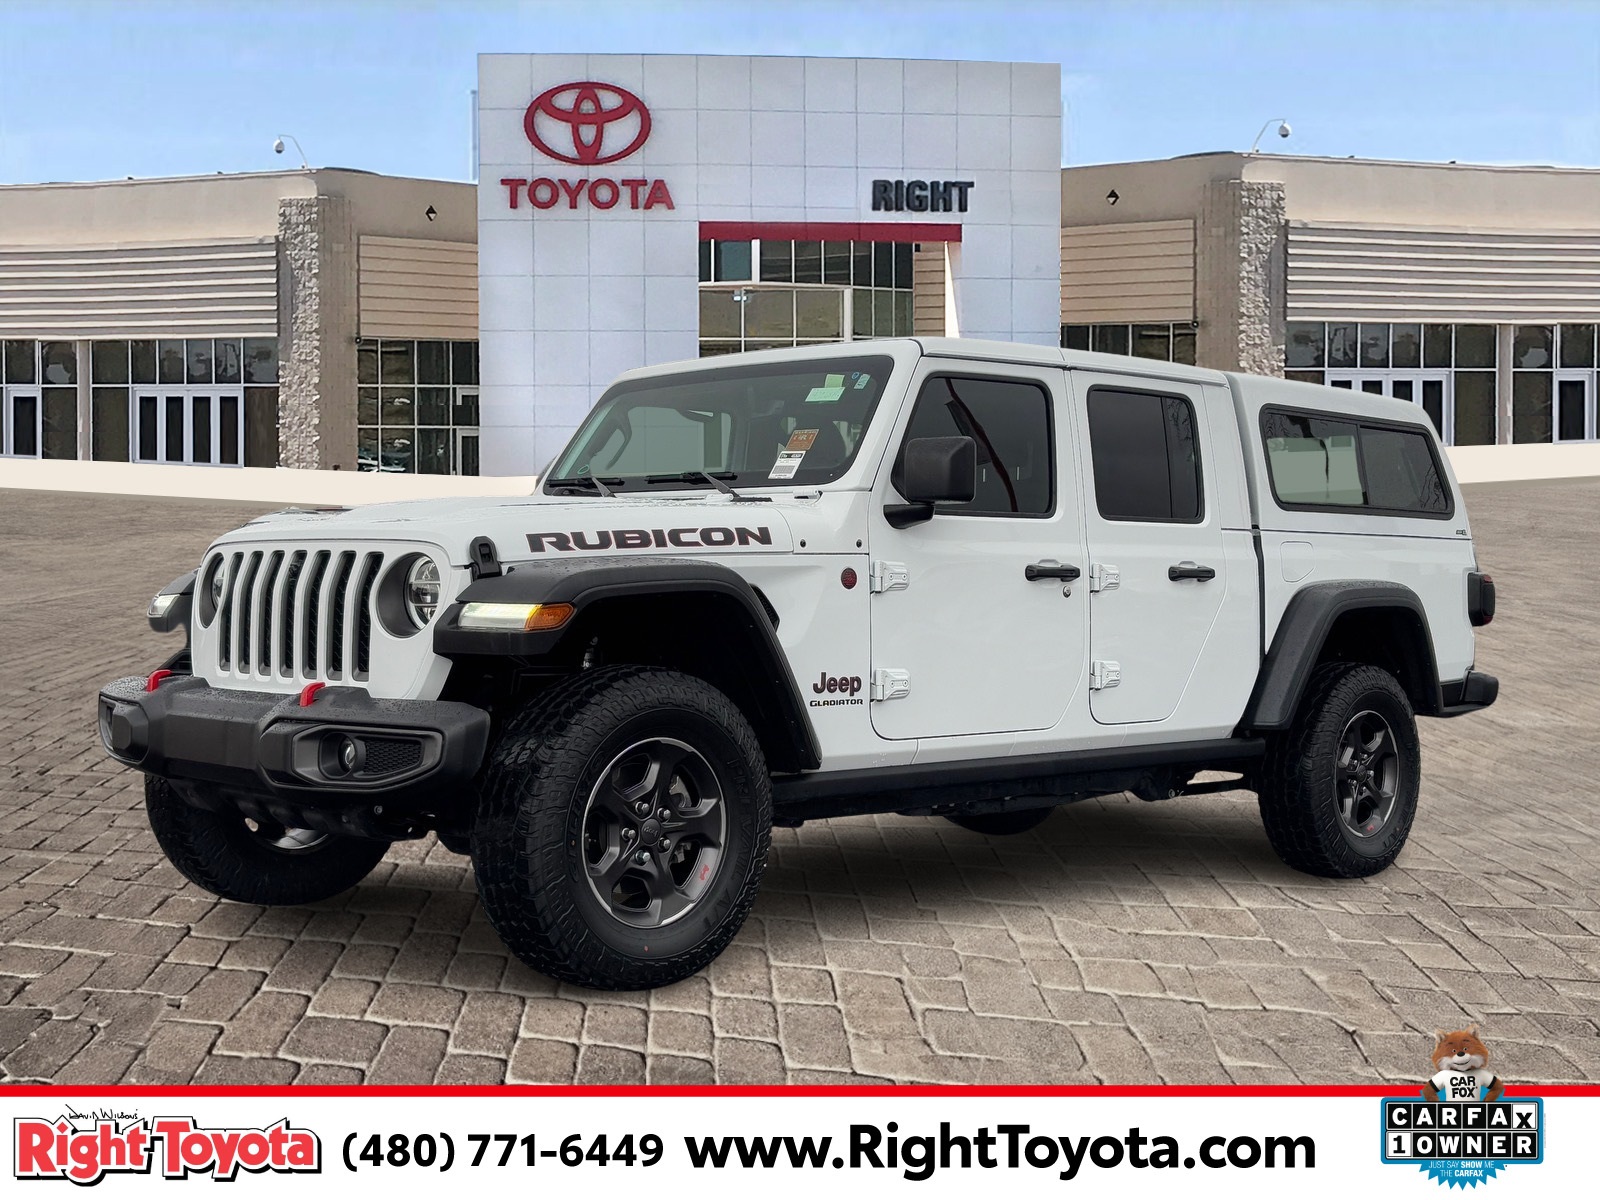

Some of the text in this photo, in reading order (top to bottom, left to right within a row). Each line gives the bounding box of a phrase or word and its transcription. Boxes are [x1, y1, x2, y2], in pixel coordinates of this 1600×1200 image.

[501, 179, 674, 210] TOYOTA
[872, 179, 975, 212] RIGHT
[525, 526, 773, 553] RUBICON
[812, 672, 862, 697] Jeep
[809, 698, 863, 707] GLADIATOR
